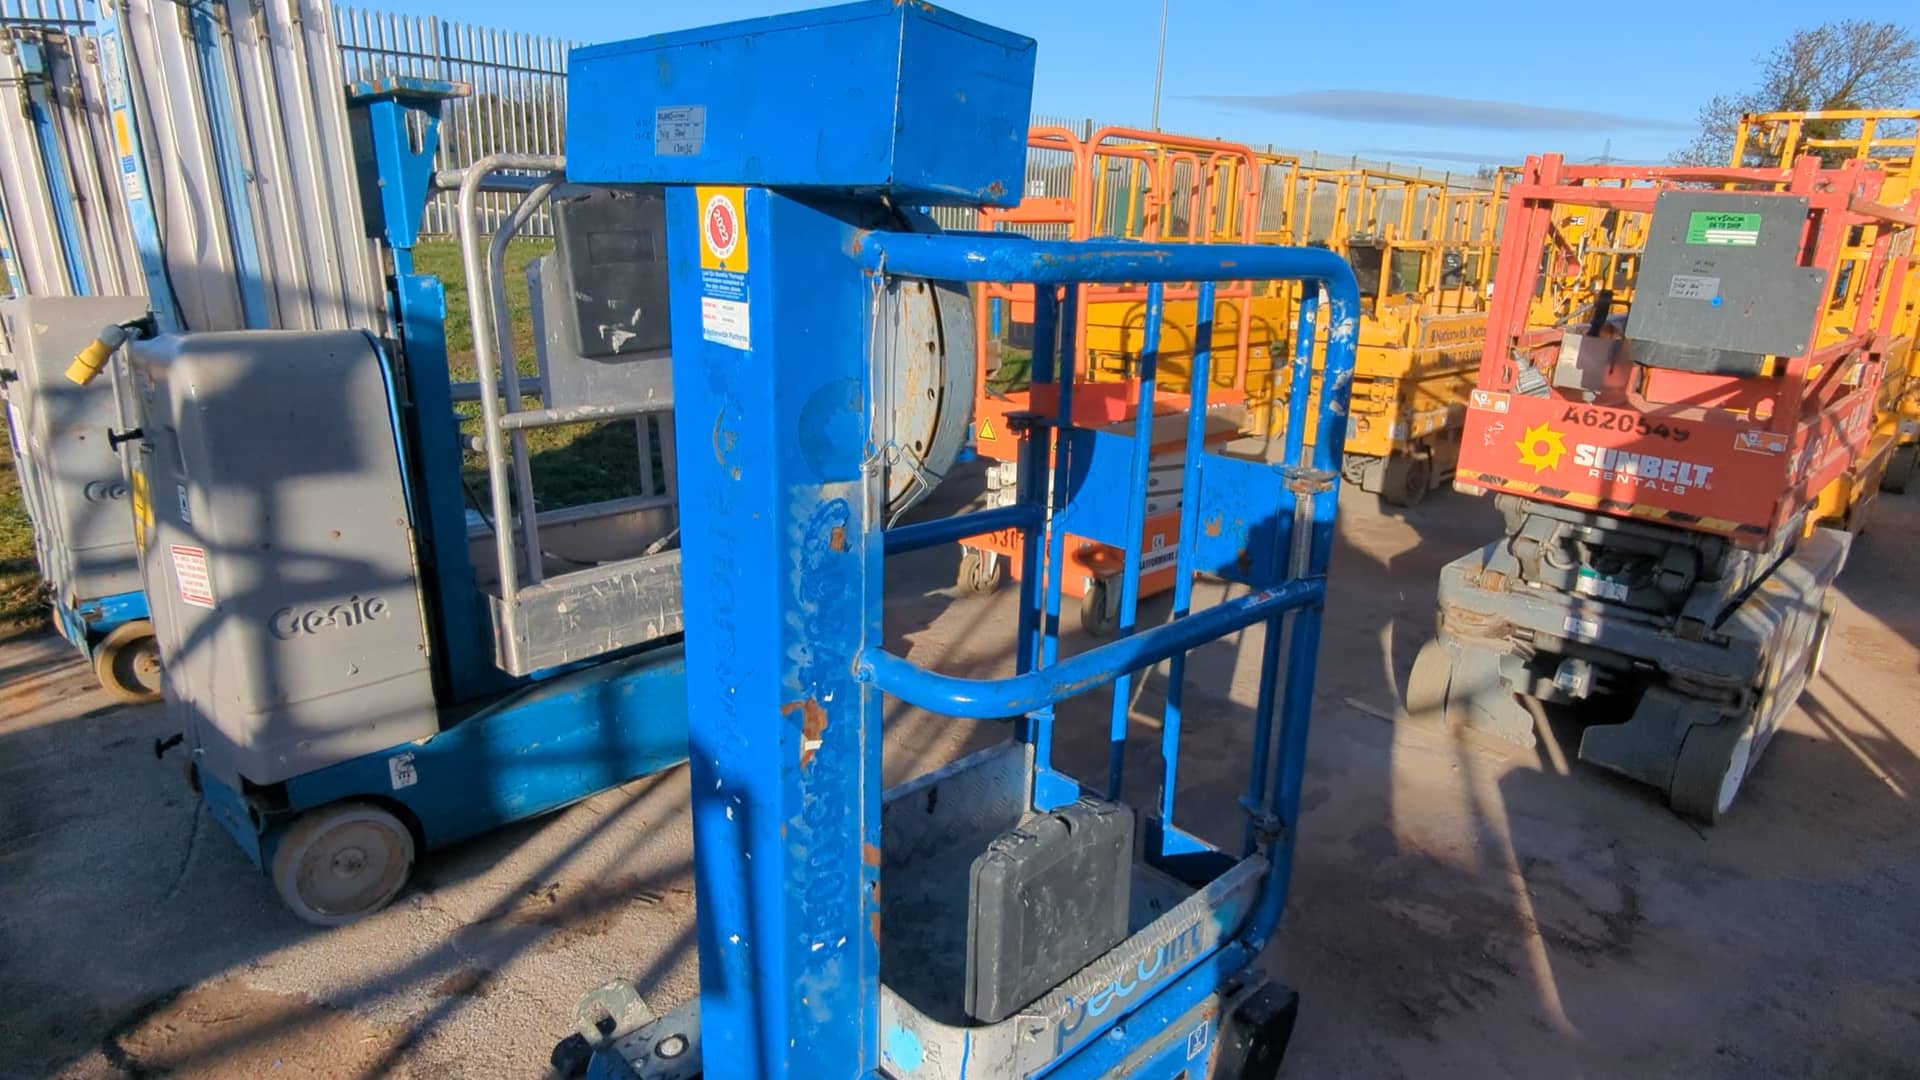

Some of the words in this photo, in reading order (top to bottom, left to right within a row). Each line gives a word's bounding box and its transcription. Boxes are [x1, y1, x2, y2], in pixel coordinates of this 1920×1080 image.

[713, 208, 729, 243] 2022
[1562, 406, 1690, 442] A620549
[1573, 443, 1713, 489] SUNBELT
[1588, 469, 1686, 496] RENTALS
[268, 595, 387, 640] Genie
